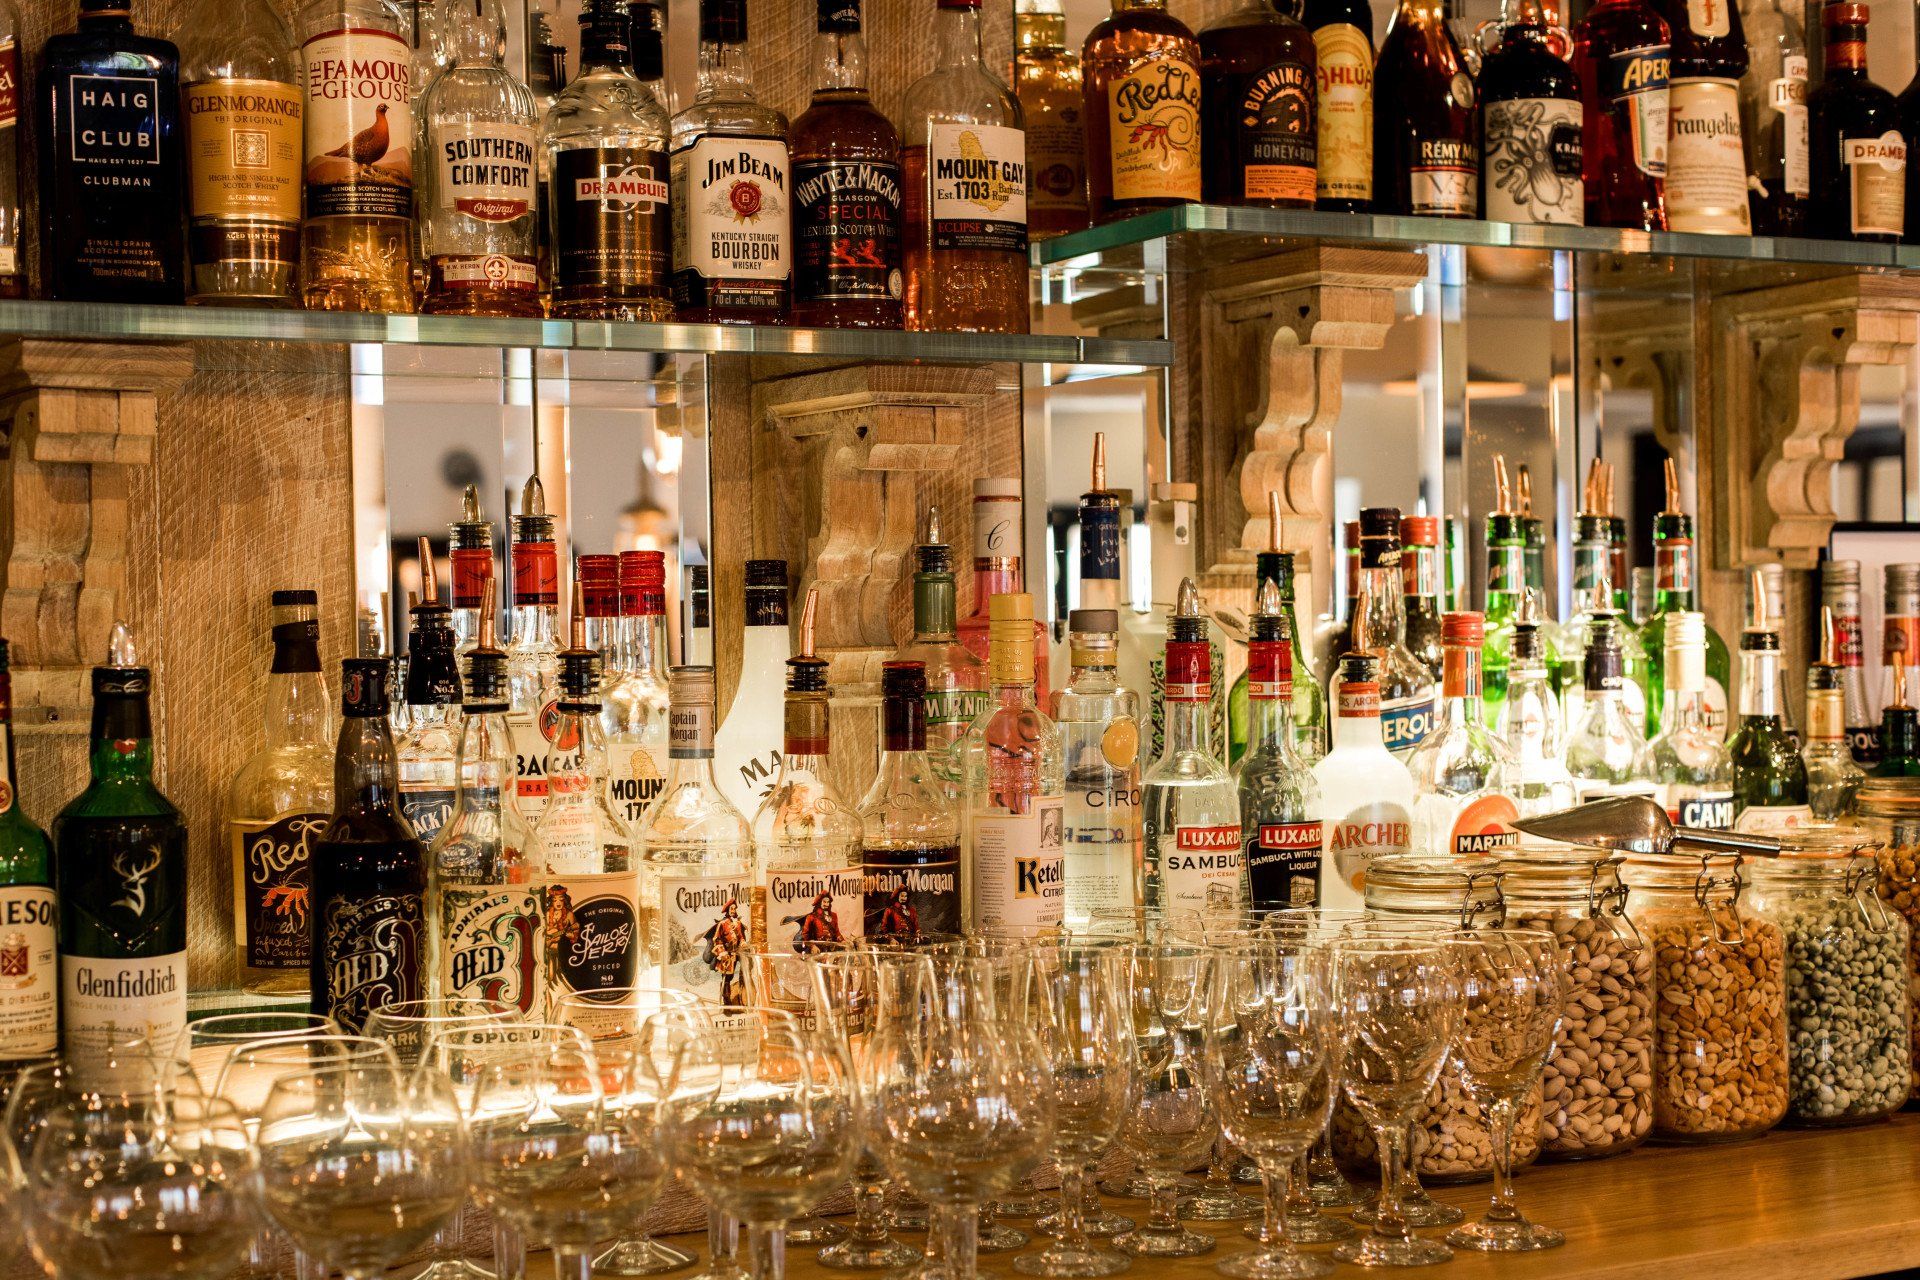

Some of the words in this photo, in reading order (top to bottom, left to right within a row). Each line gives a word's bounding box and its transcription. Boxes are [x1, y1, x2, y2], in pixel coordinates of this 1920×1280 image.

[310, 61, 322, 102] THE
[322, 60, 409, 85] FAMOUS
[322, 80, 409, 104] GROUSE
[1116, 63, 1181, 124] Red
[1244, 68, 1303, 111] BURNING
[82, 90, 148, 108] HAIG
[189, 96, 300, 119] GLENMORANGIE
[233, 116, 284, 126] ORIGINAL
[82, 129, 150, 147] CLUB
[445, 138, 532, 166] SOUTHERN
[1254, 144, 1294, 159] HONEY
[1422, 141, 1460, 159] RÉMY
[702, 158, 735, 189] JIM
[738, 152, 784, 193] BEAM
[937, 158, 999, 180] MOUNT
[1002, 162, 1024, 184] GAY
[84, 176, 151, 187] CLUBMAN
[580, 181, 668, 200] DRAMBUIE
[795, 168, 843, 208] WHYTE
[858, 164, 901, 210] MACKAY
[998, 182, 1024, 196] Barbados
[832, 194, 878, 202] GLASGOW
[937, 188, 955, 200] Est.
[954, 182, 990, 200] 1703
[992, 190, 1010, 202] Rum
[473, 202, 516, 215] Original
[817, 204, 891, 221] SPECIAL
[802, 224, 838, 237] LENDED
[840, 222, 877, 237] SCOTCH
[938, 222, 982, 234] ECLIPSE
[122, 240, 151, 248] GRAIN
[712, 232, 747, 242] KENTUCKY
[748, 232, 780, 243] STRAIGHT
[712, 242, 780, 260] BOURBON
[732, 261, 762, 270] WHISKEY
[714, 294, 724, 305] 70
[735, 296, 748, 305] alc.
[748, 296, 765, 306] 40%
[766, 296, 779, 306] vol.
[670, 710, 697, 728] Captain
[612, 778, 667, 801] MOUN
[625, 802, 651, 821] 17
[1329, 822, 1412, 852] ARCHER
[1460, 832, 1518, 852] MARTINI
[250, 816, 328, 884] Red
[1250, 853, 1293, 867] SAMBUCA
[1294, 850, 1312, 860] WITH
[1288, 861, 1318, 871] LIQUEUR
[902, 868, 955, 894] Morgan
[1017, 859, 1060, 896] Ketel
[676, 883, 728, 911] Captain
[772, 876, 824, 902] Captain
[450, 894, 510, 942] ADMIRAL'S
[598, 907, 625, 915] ORIGINAL
[332, 900, 393, 949] ADMIRAL'S
[333, 952, 389, 999] OLD
[451, 946, 505, 991] OLD
[592, 962, 621, 971] SPICED
[76, 966, 176, 998] Glenfiddich
[386, 1030, 419, 1046] ARK
[472, 1030, 541, 1044] SPICD
